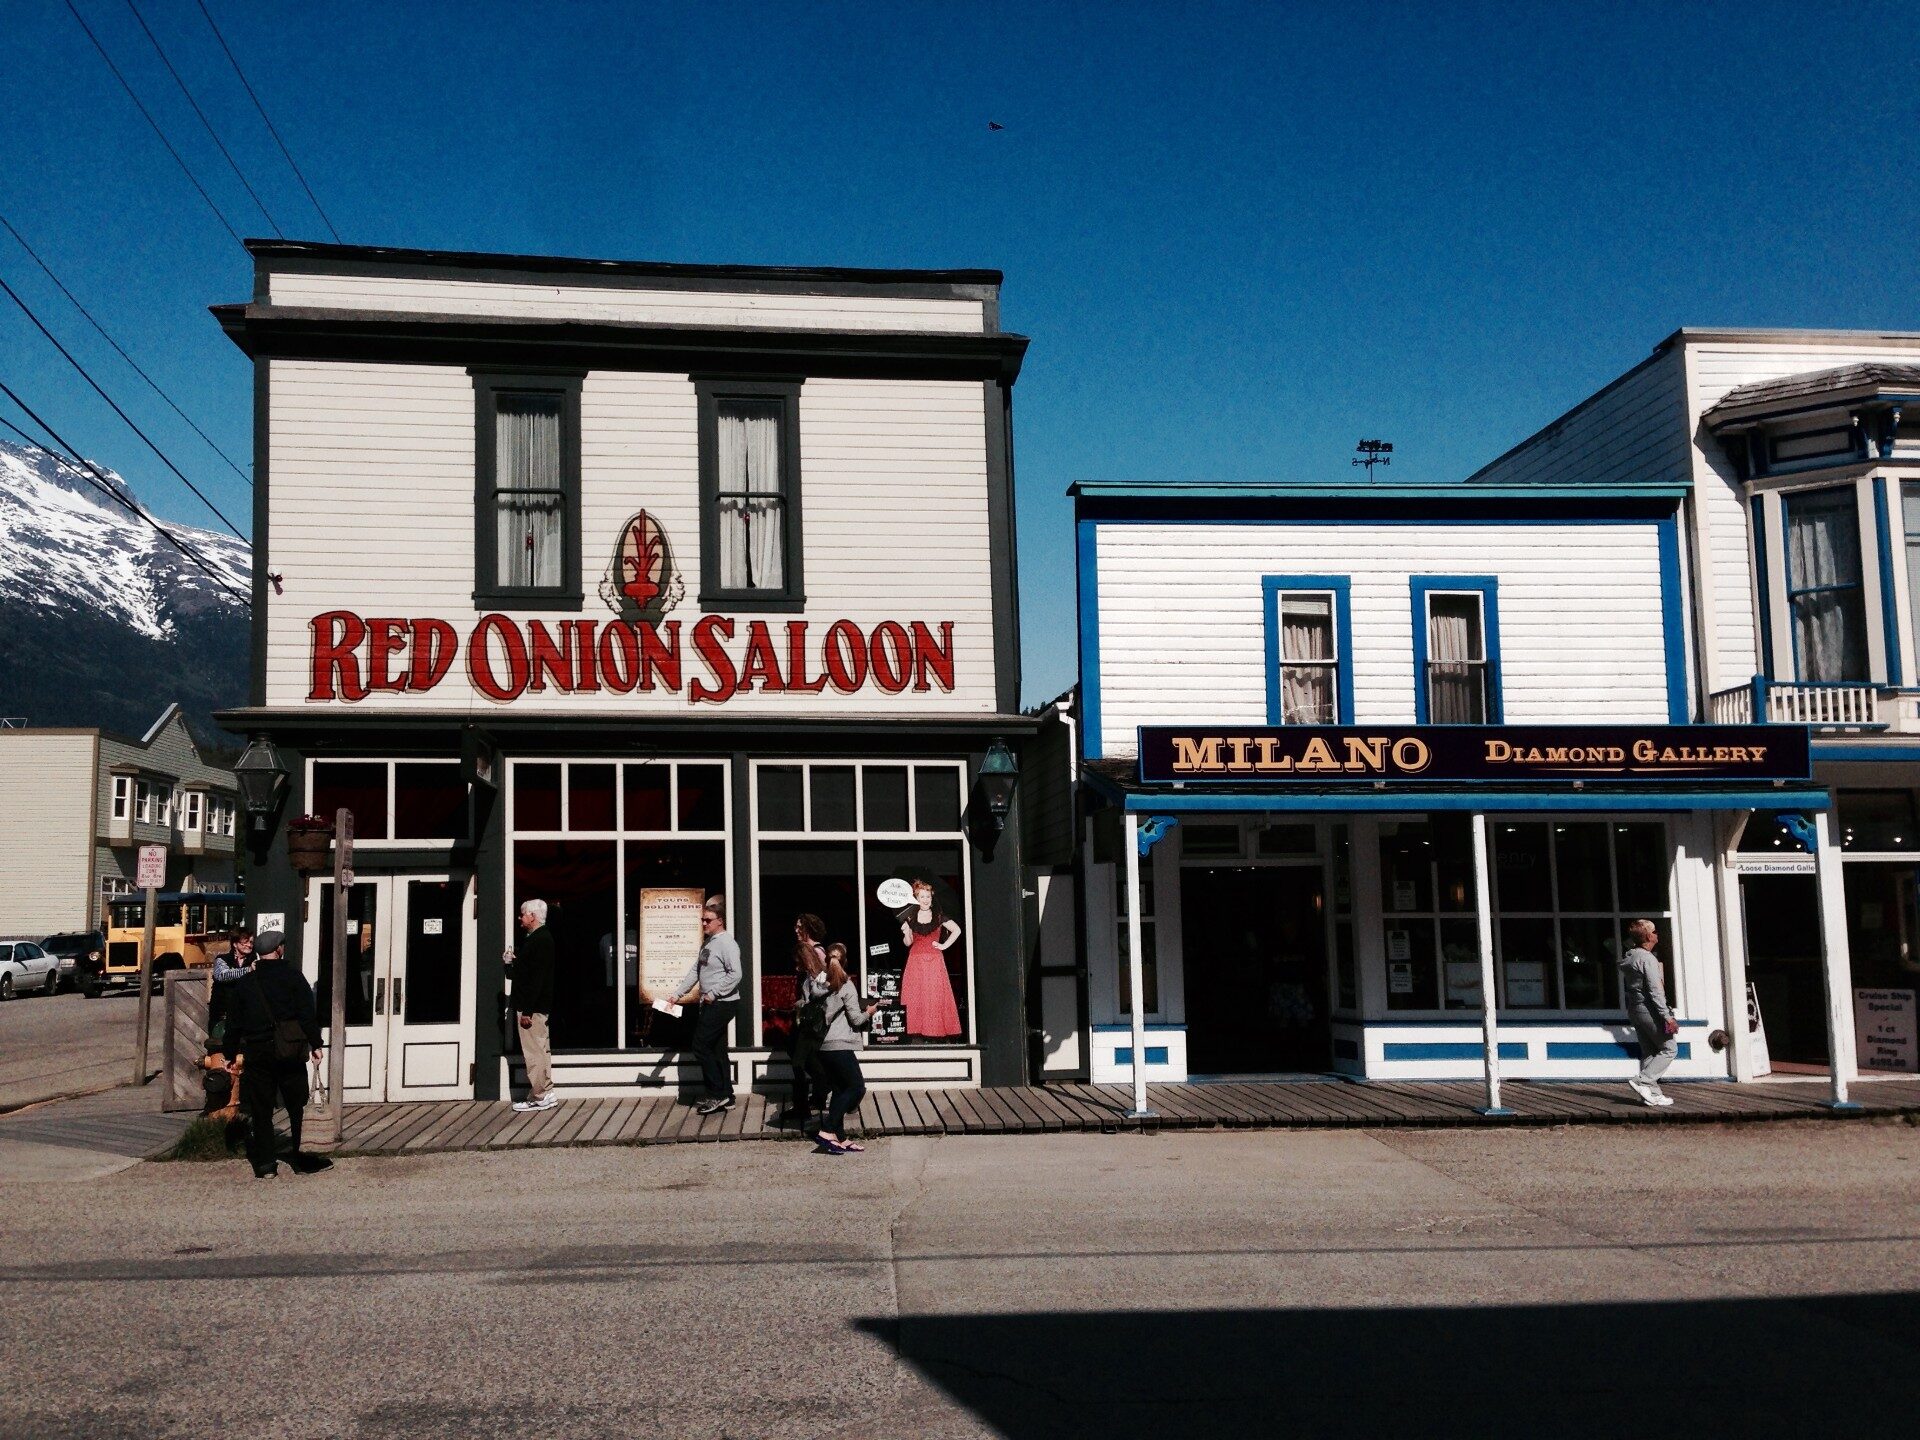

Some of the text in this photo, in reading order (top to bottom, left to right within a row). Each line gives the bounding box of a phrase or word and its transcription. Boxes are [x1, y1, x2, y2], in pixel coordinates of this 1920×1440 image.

[307, 611, 955, 706] RED ONION SALOON
[1171, 736, 1767, 774] MILANO DIAMOND GALLERY
[1738, 864, 1815, 872] Loose Diamond Galle
[1858, 991, 1912, 1001] Cruise Ship
[1868, 1003, 1903, 1012] Special
[1867, 1035, 1907, 1044] Diamond
[1877, 1047, 1898, 1057] Ring
